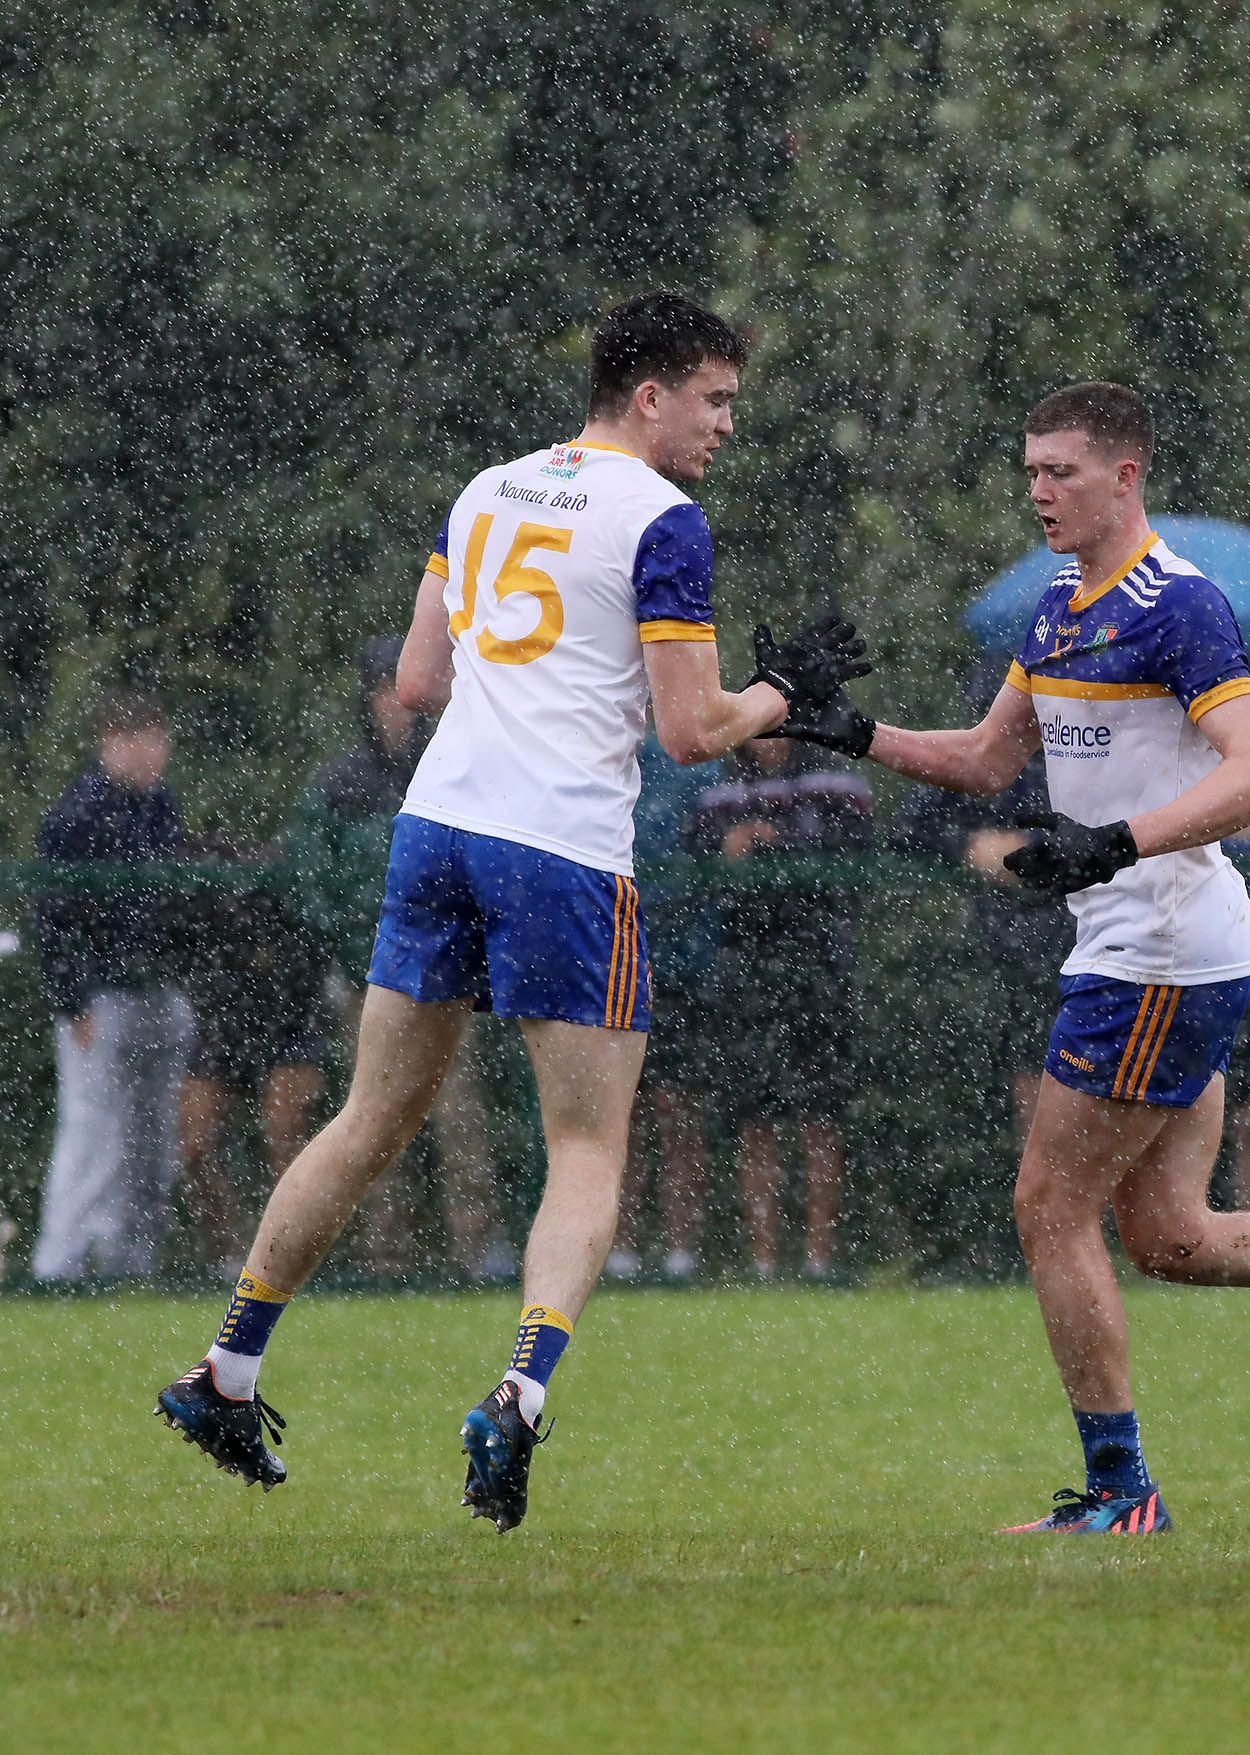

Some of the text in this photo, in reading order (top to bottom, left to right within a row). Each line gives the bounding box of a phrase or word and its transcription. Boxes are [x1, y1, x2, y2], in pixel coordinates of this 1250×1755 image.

[554, 447, 566, 456] WE
[548, 458, 565, 467] ARE
[540, 465, 578, 479] DONORS
[449, 512, 574, 665] 15
[1070, 749, 1111, 759] Foodservice
